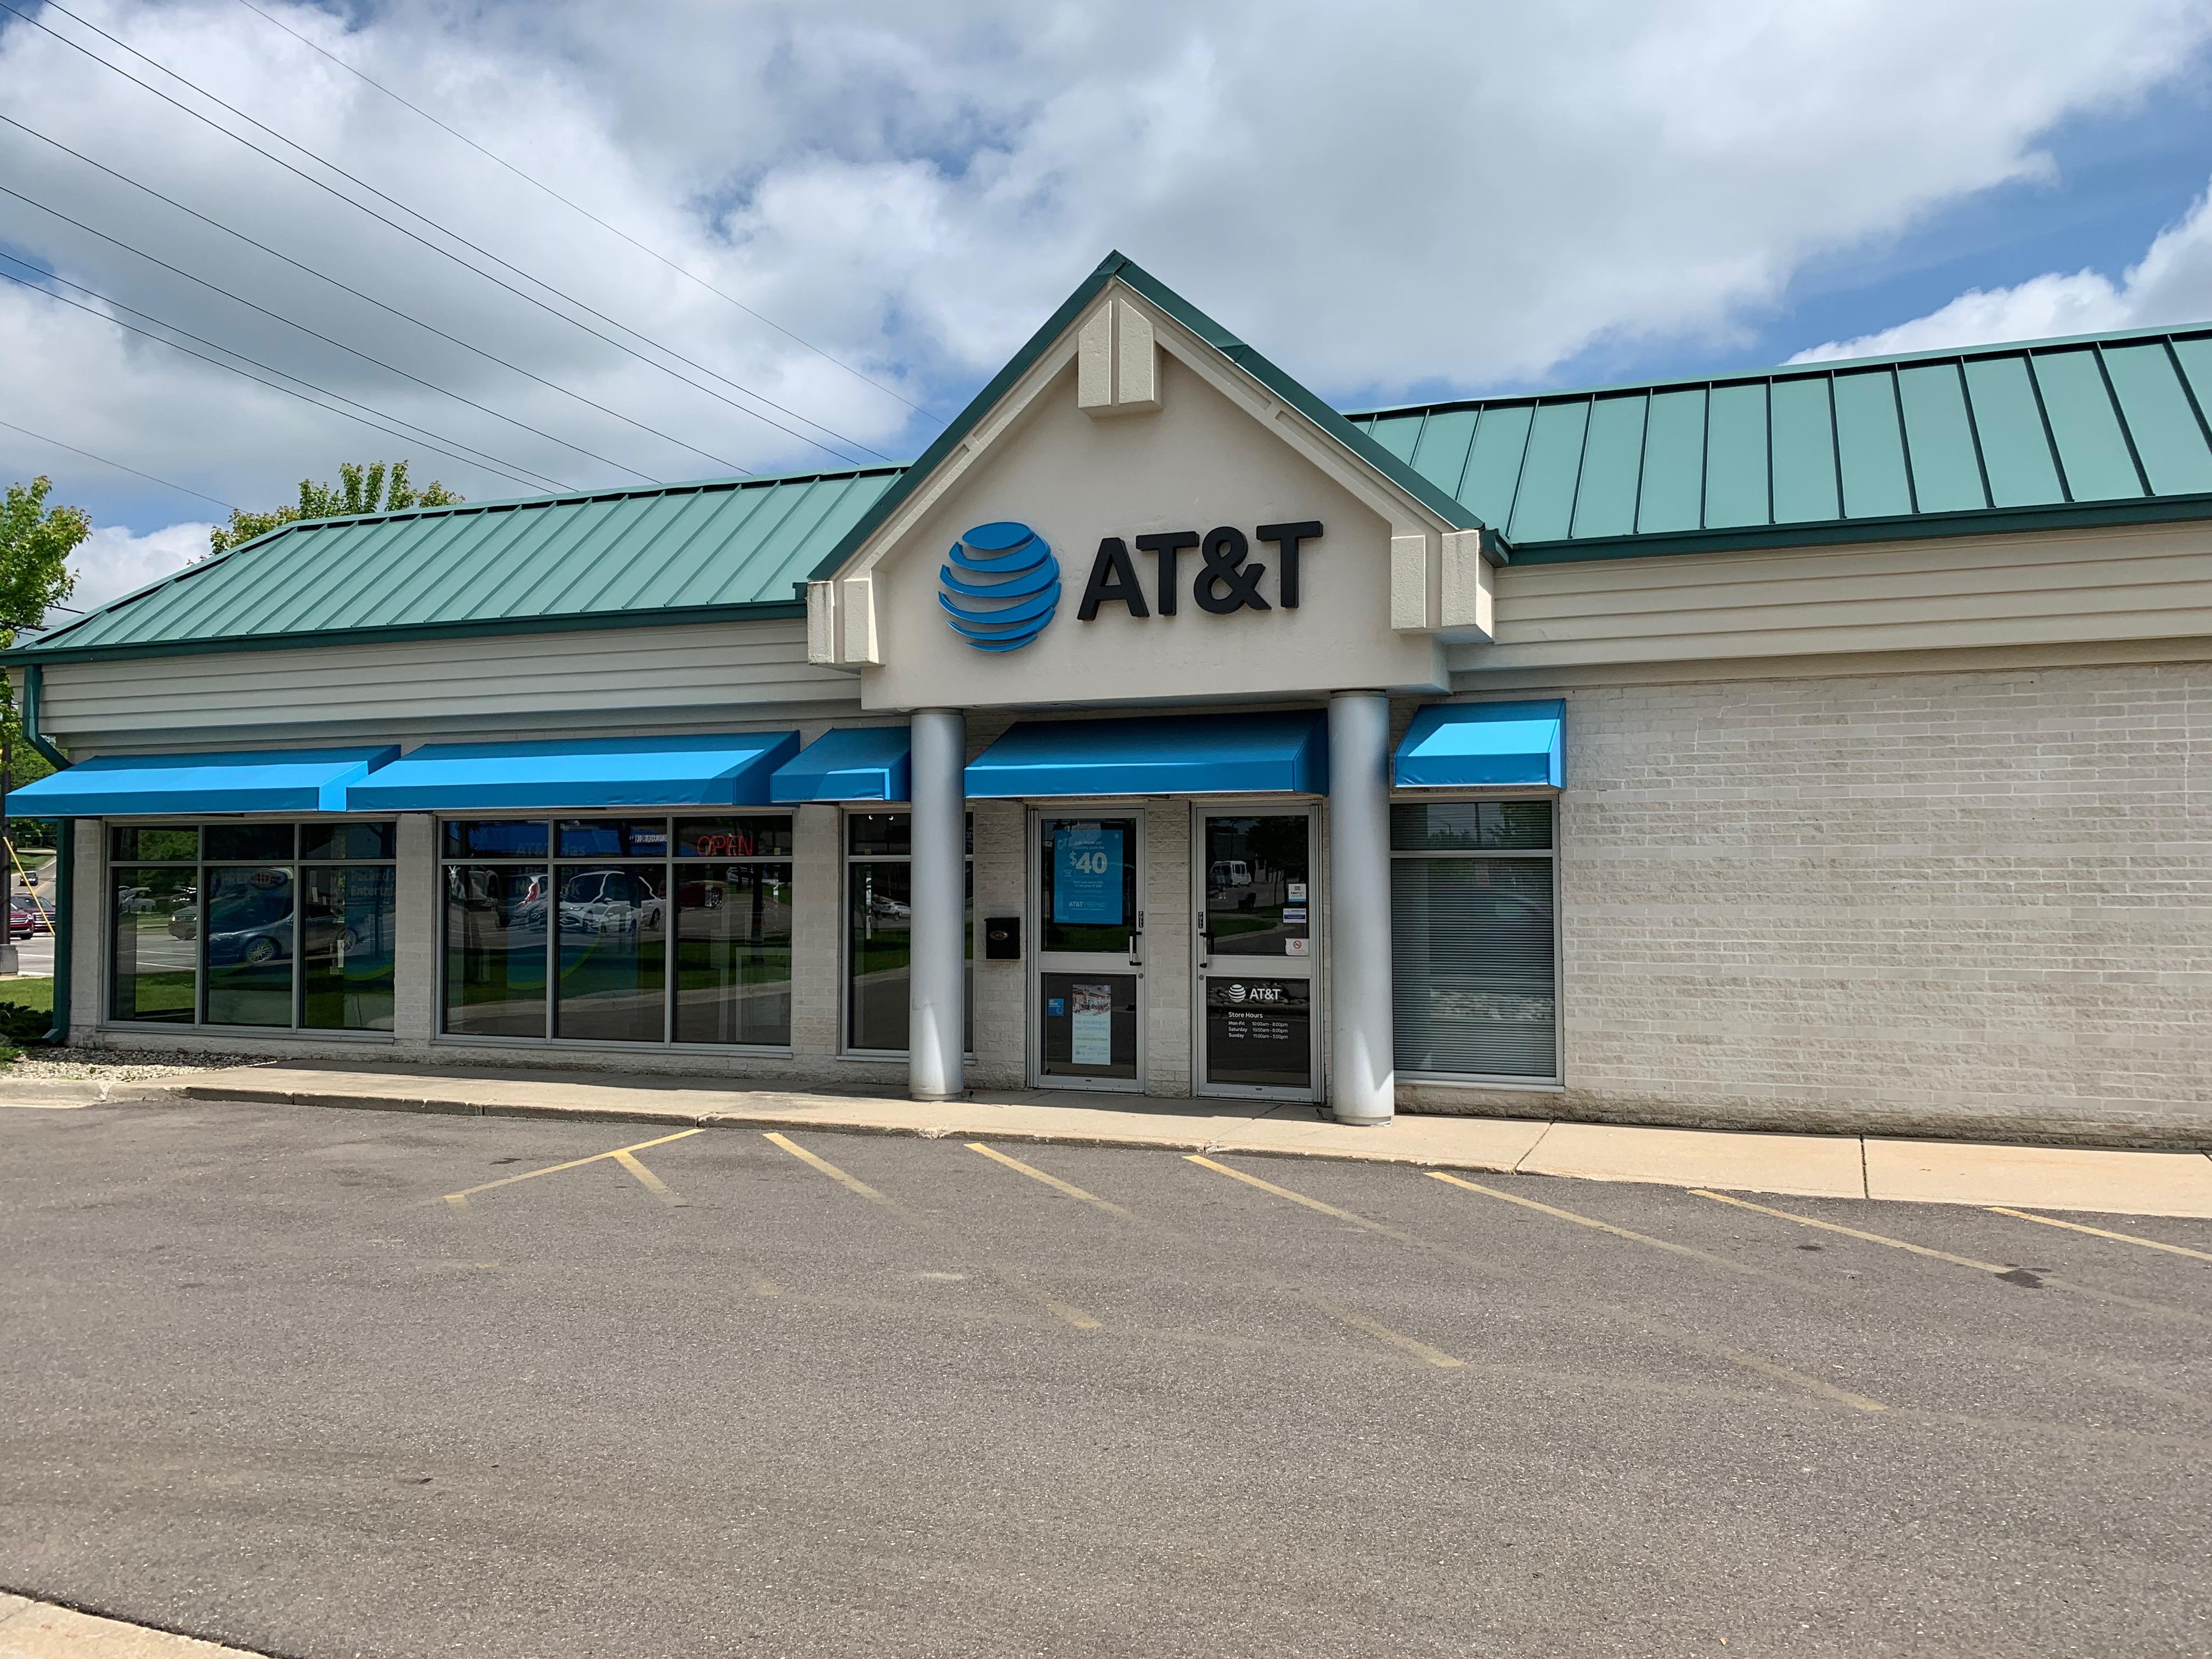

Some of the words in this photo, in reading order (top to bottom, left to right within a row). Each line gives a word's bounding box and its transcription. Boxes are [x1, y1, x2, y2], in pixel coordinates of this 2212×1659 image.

[1076, 520, 1323, 621] AT&T
[697, 834, 753, 856] OPEN
[1069, 851, 1108, 874] $40
[1249, 988, 1282, 1000] AT&T
